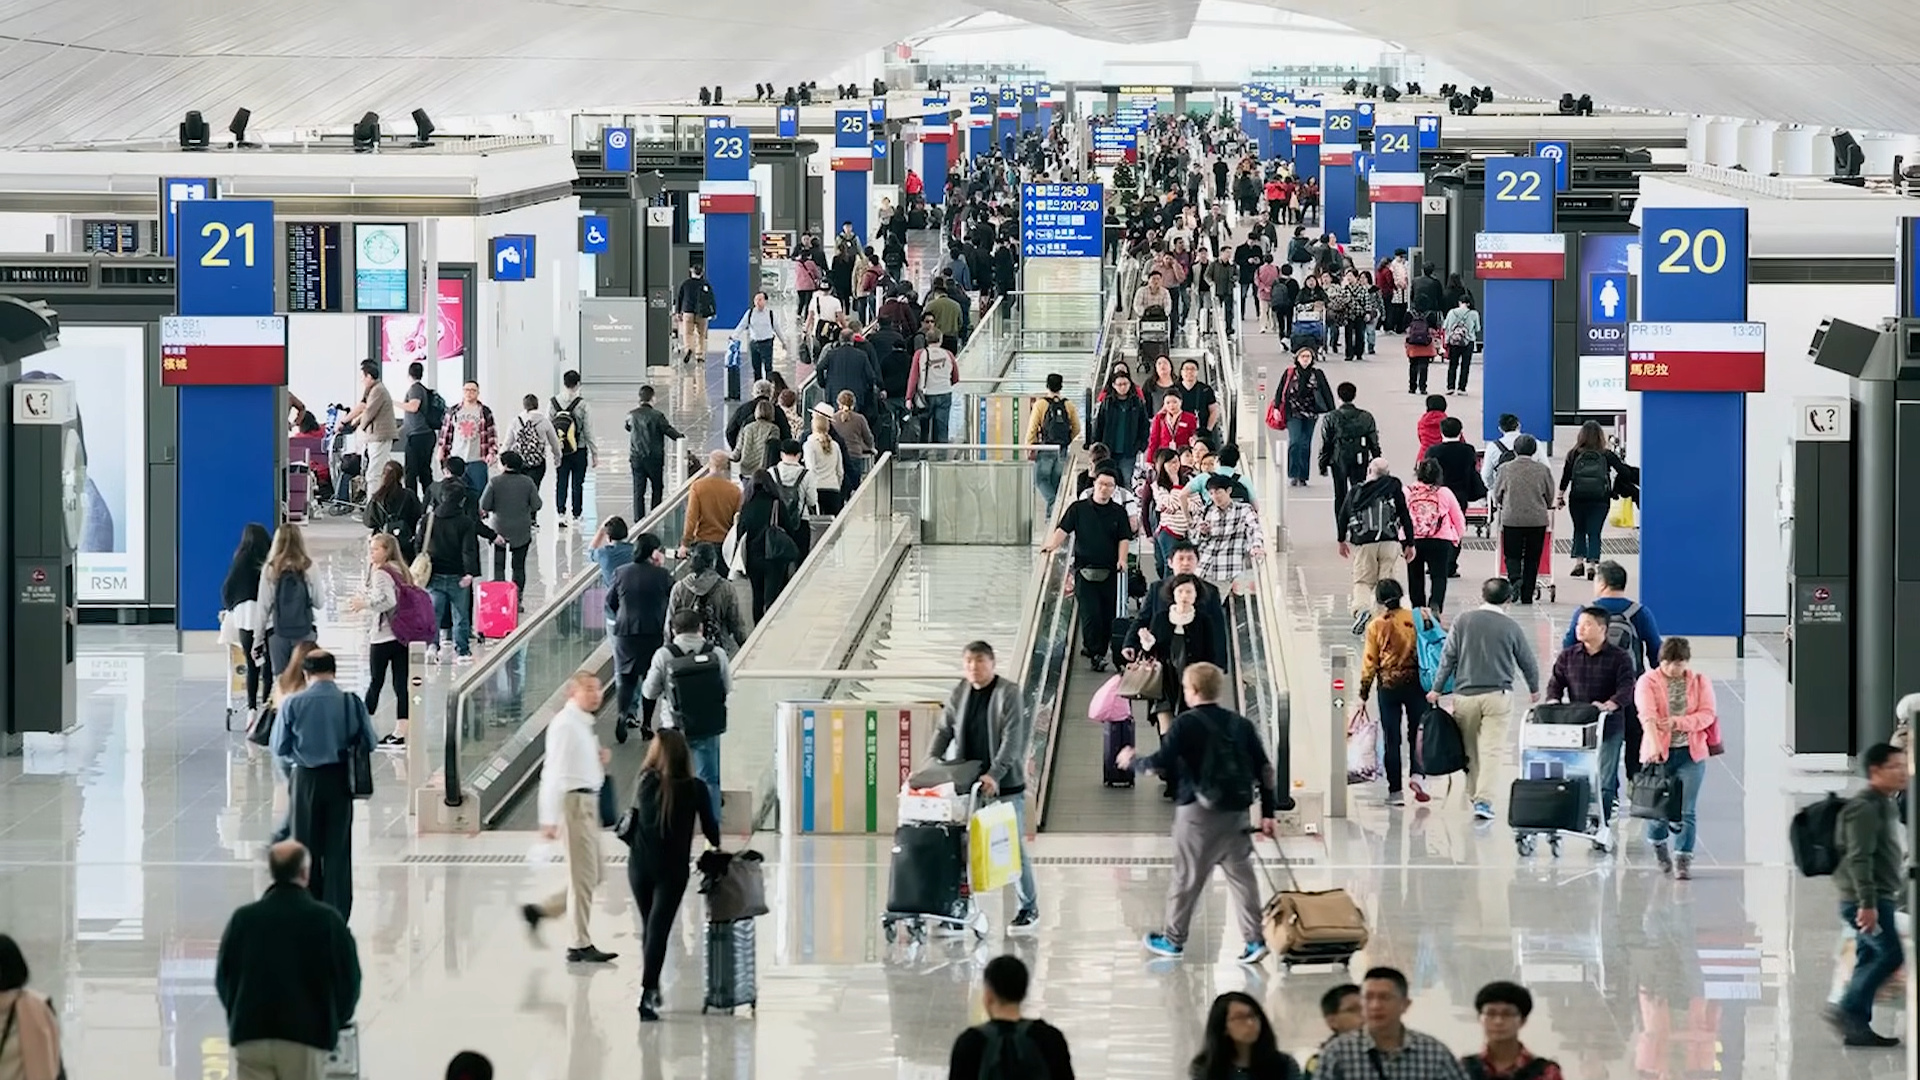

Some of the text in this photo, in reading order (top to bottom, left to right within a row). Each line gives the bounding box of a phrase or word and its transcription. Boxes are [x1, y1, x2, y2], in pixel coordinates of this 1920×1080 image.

[973, 95, 987, 106] 29
[1003, 90, 1014, 100] 31
[841, 117, 863, 133] 25
[1328, 115, 1351, 130] 26
[714, 137, 743, 159] 23
[1381, 133, 1410, 153] 24
[1496, 171, 1541, 201] 22
[1060, 200, 1099, 211] 201-230
[200, 222, 254, 267] 21
[1658, 229, 1726, 274] 20
[164, 319, 283, 330] KA 691 15:10
[1631, 325, 1762, 337] PR 319 13:20
[1588, 328, 1620, 340] OLED
[1629, 363, 1669, 376] 馬尼拉
[91, 576, 128, 590] RSM
